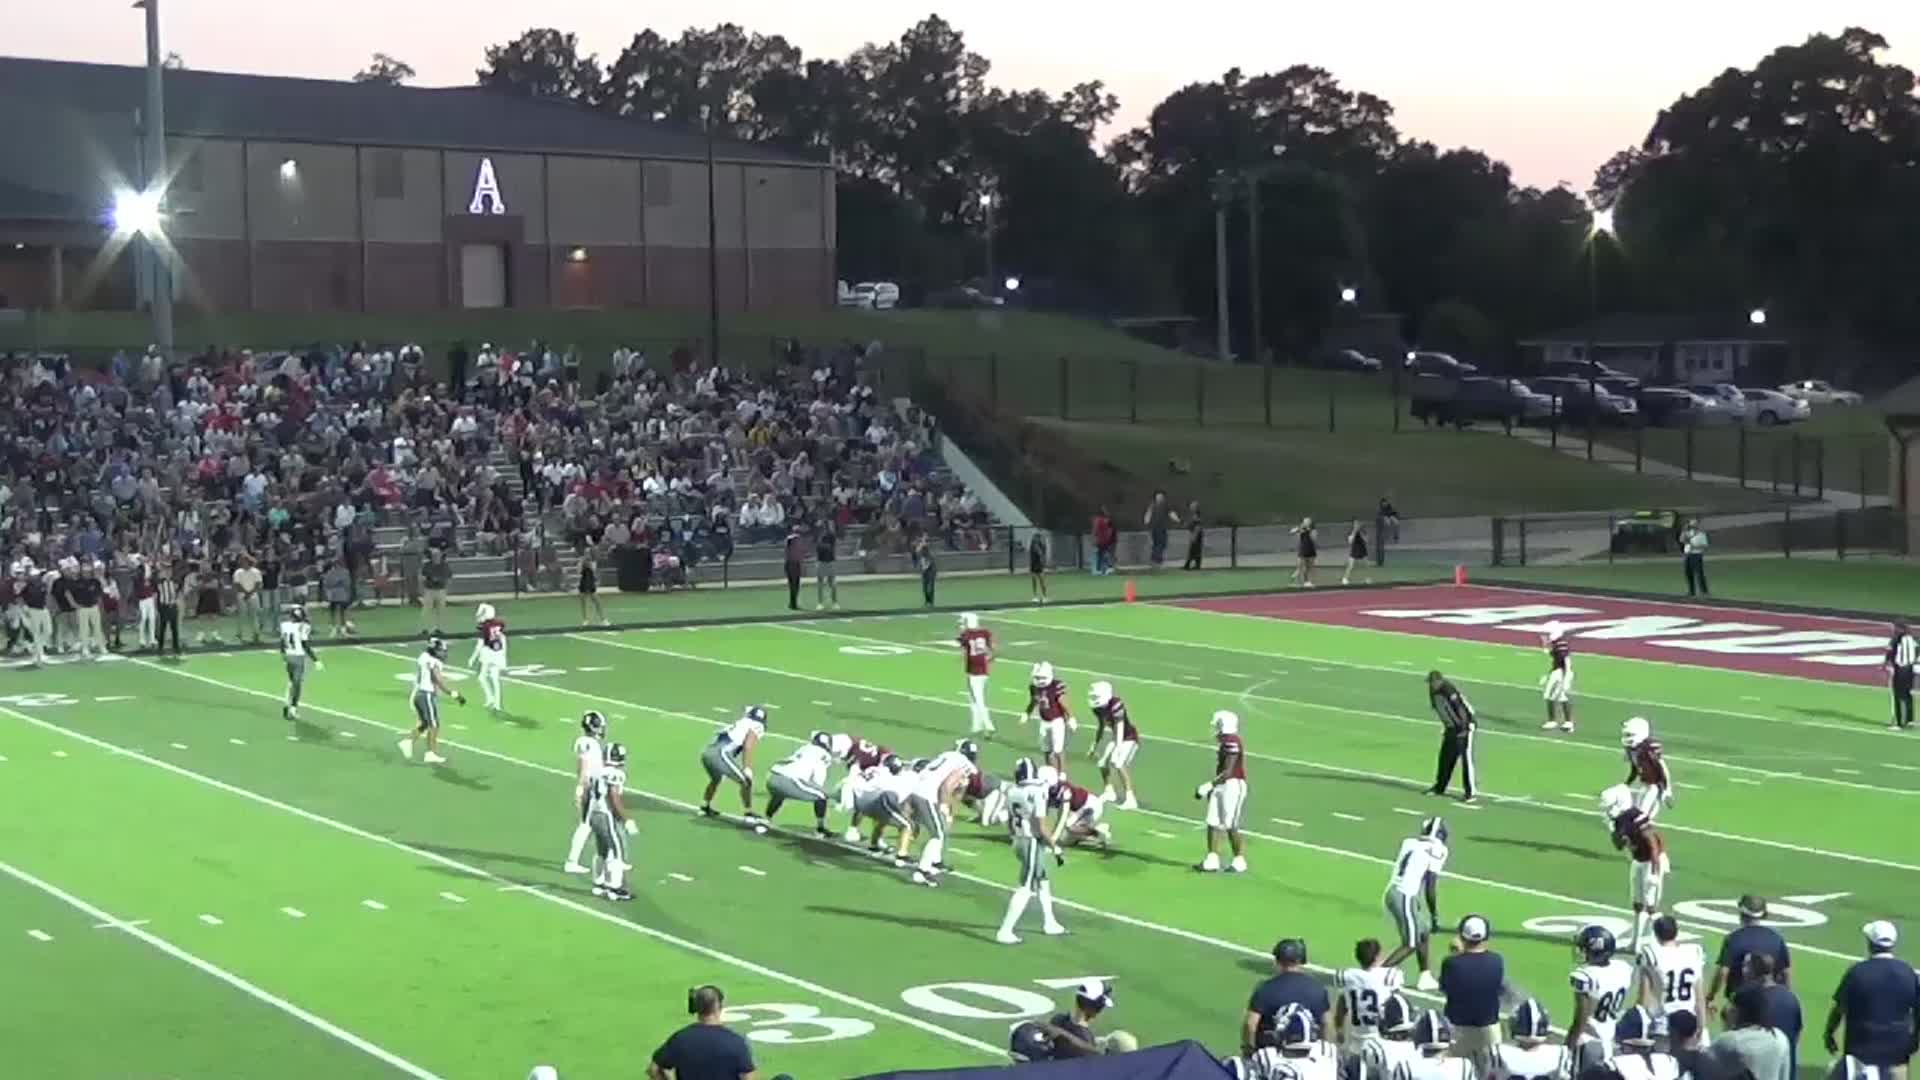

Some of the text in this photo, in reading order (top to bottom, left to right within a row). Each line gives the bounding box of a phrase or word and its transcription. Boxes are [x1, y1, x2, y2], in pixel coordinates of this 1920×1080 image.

[1666, 968, 1694, 1002] 16
[1350, 989, 1379, 1027] 13
[1594, 987, 1626, 1023] 80
